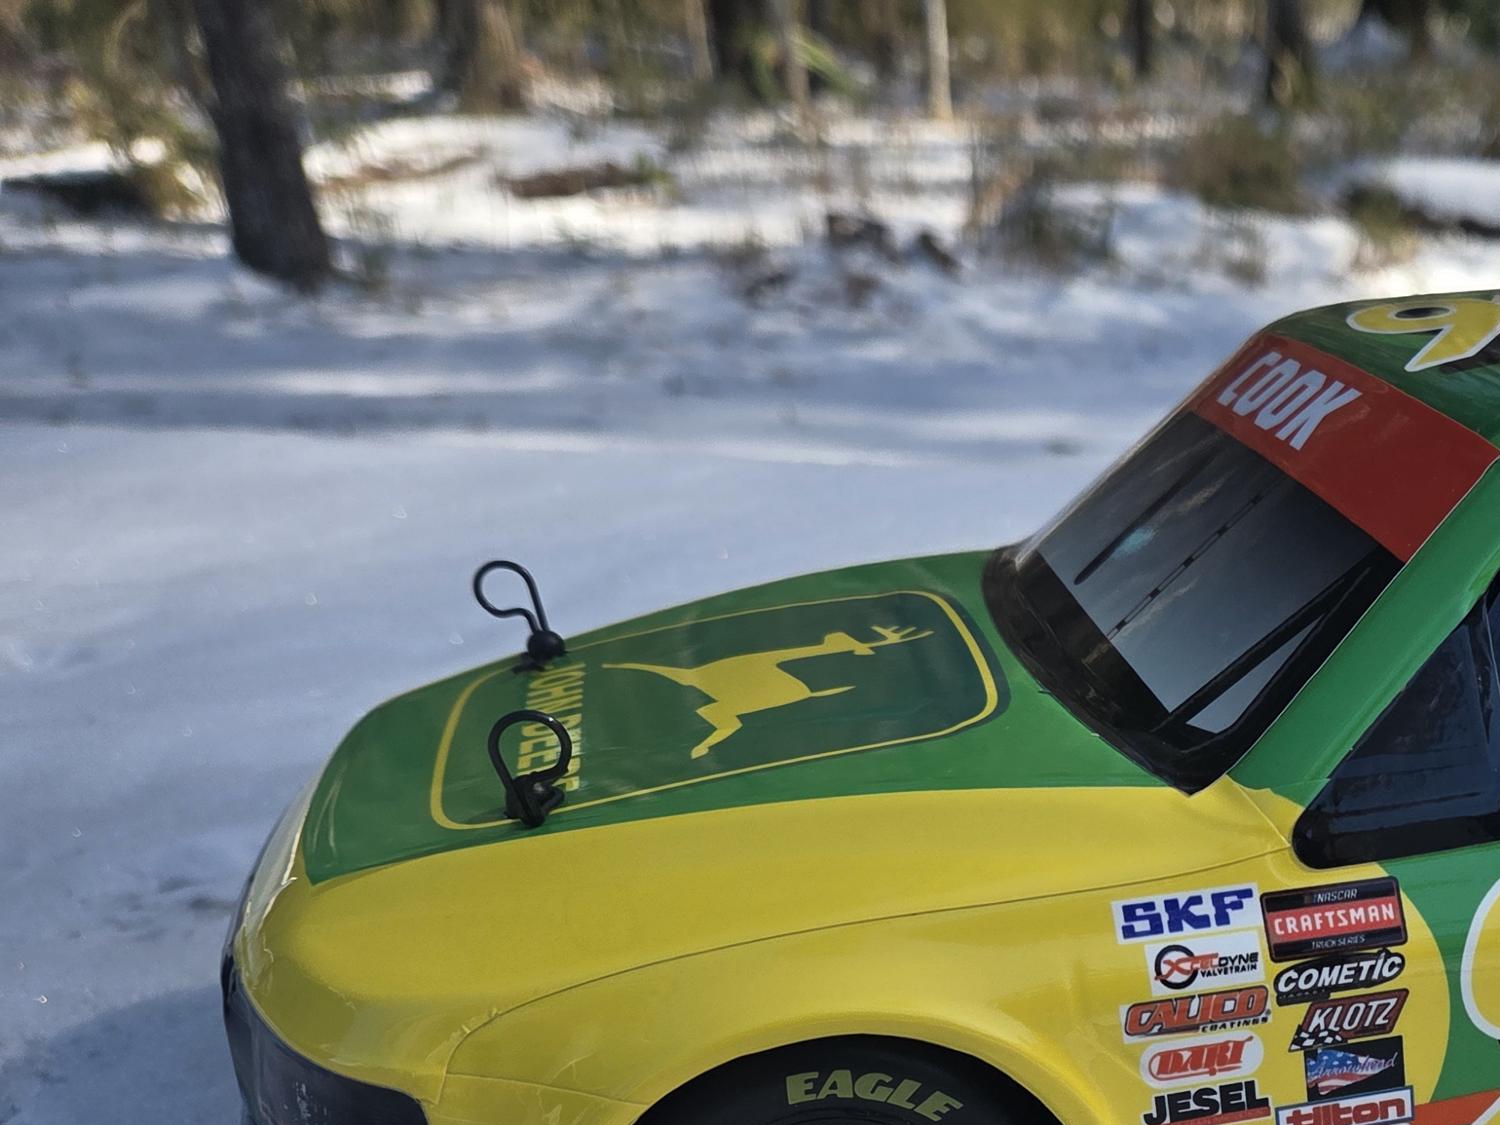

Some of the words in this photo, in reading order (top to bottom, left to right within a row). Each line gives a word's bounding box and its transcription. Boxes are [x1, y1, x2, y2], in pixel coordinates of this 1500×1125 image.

[1216, 350, 1364, 451] COOK
[1121, 887, 1254, 939] SKF
[1313, 888, 1358, 903] NASCAR
[1274, 902, 1395, 935] CRAFTSMAN
[1311, 938, 1336, 950] TRUCK
[1336, 934, 1366, 948] SERIES
[1200, 963, 1258, 978] VALVETRAIN
[1278, 952, 1402, 993] COMETIC
[1200, 1016, 1269, 1033] COATINGS
[1308, 998, 1398, 1033] KLOTZ
[785, 1069, 964, 1122] EAGLE
[1143, 1080, 1269, 1125] JESEL
